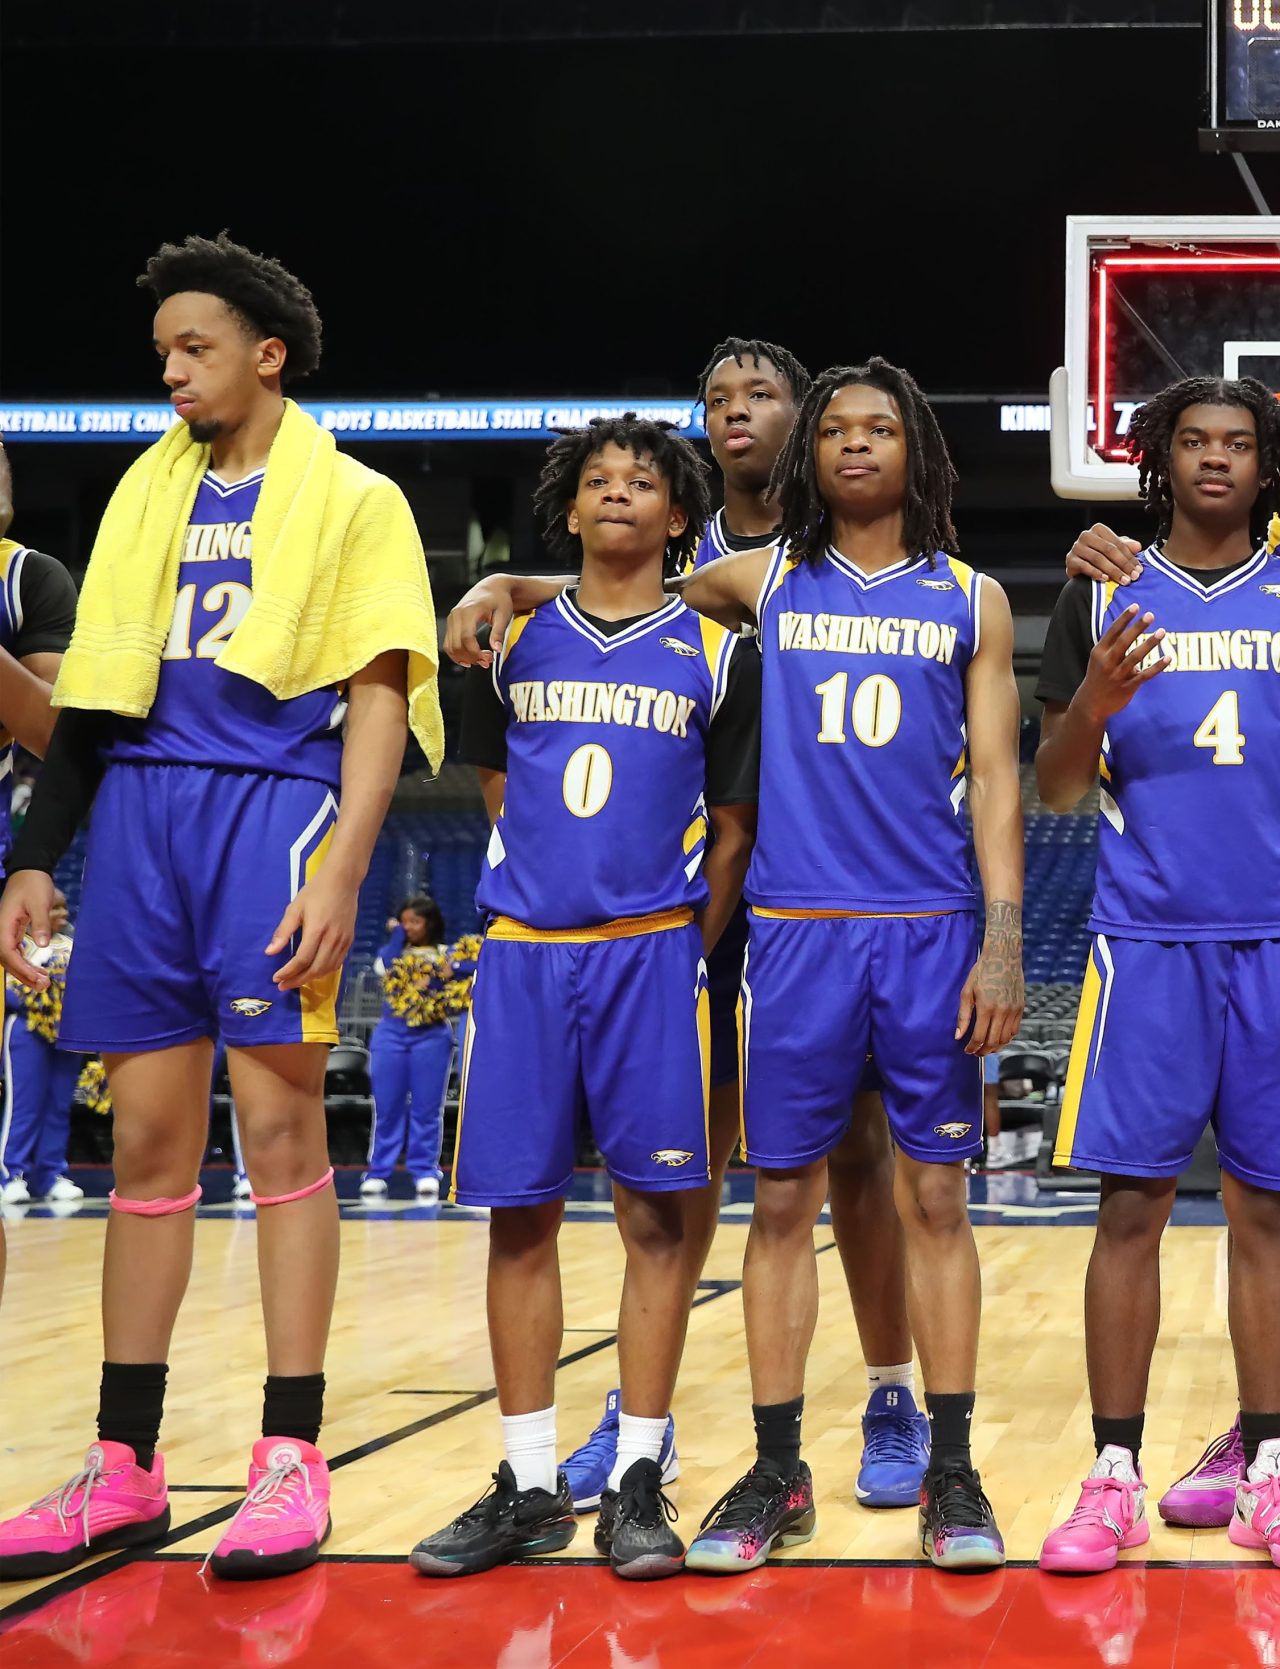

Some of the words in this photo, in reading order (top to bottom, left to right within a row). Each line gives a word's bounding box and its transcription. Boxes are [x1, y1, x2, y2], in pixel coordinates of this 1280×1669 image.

[79, 411, 132, 432] STATE
[320, 409, 372, 432] BOYS
[373, 409, 489, 431] BASKETBALL
[491, 408, 543, 430] STATE
[161, 581, 254, 661] 12
[777, 610, 958, 667] WASHINGTON
[508, 680, 697, 739] WASHINGTON
[814, 671, 902, 748] 10
[1193, 690, 1247, 766] 4
[562, 743, 614, 819] 0
